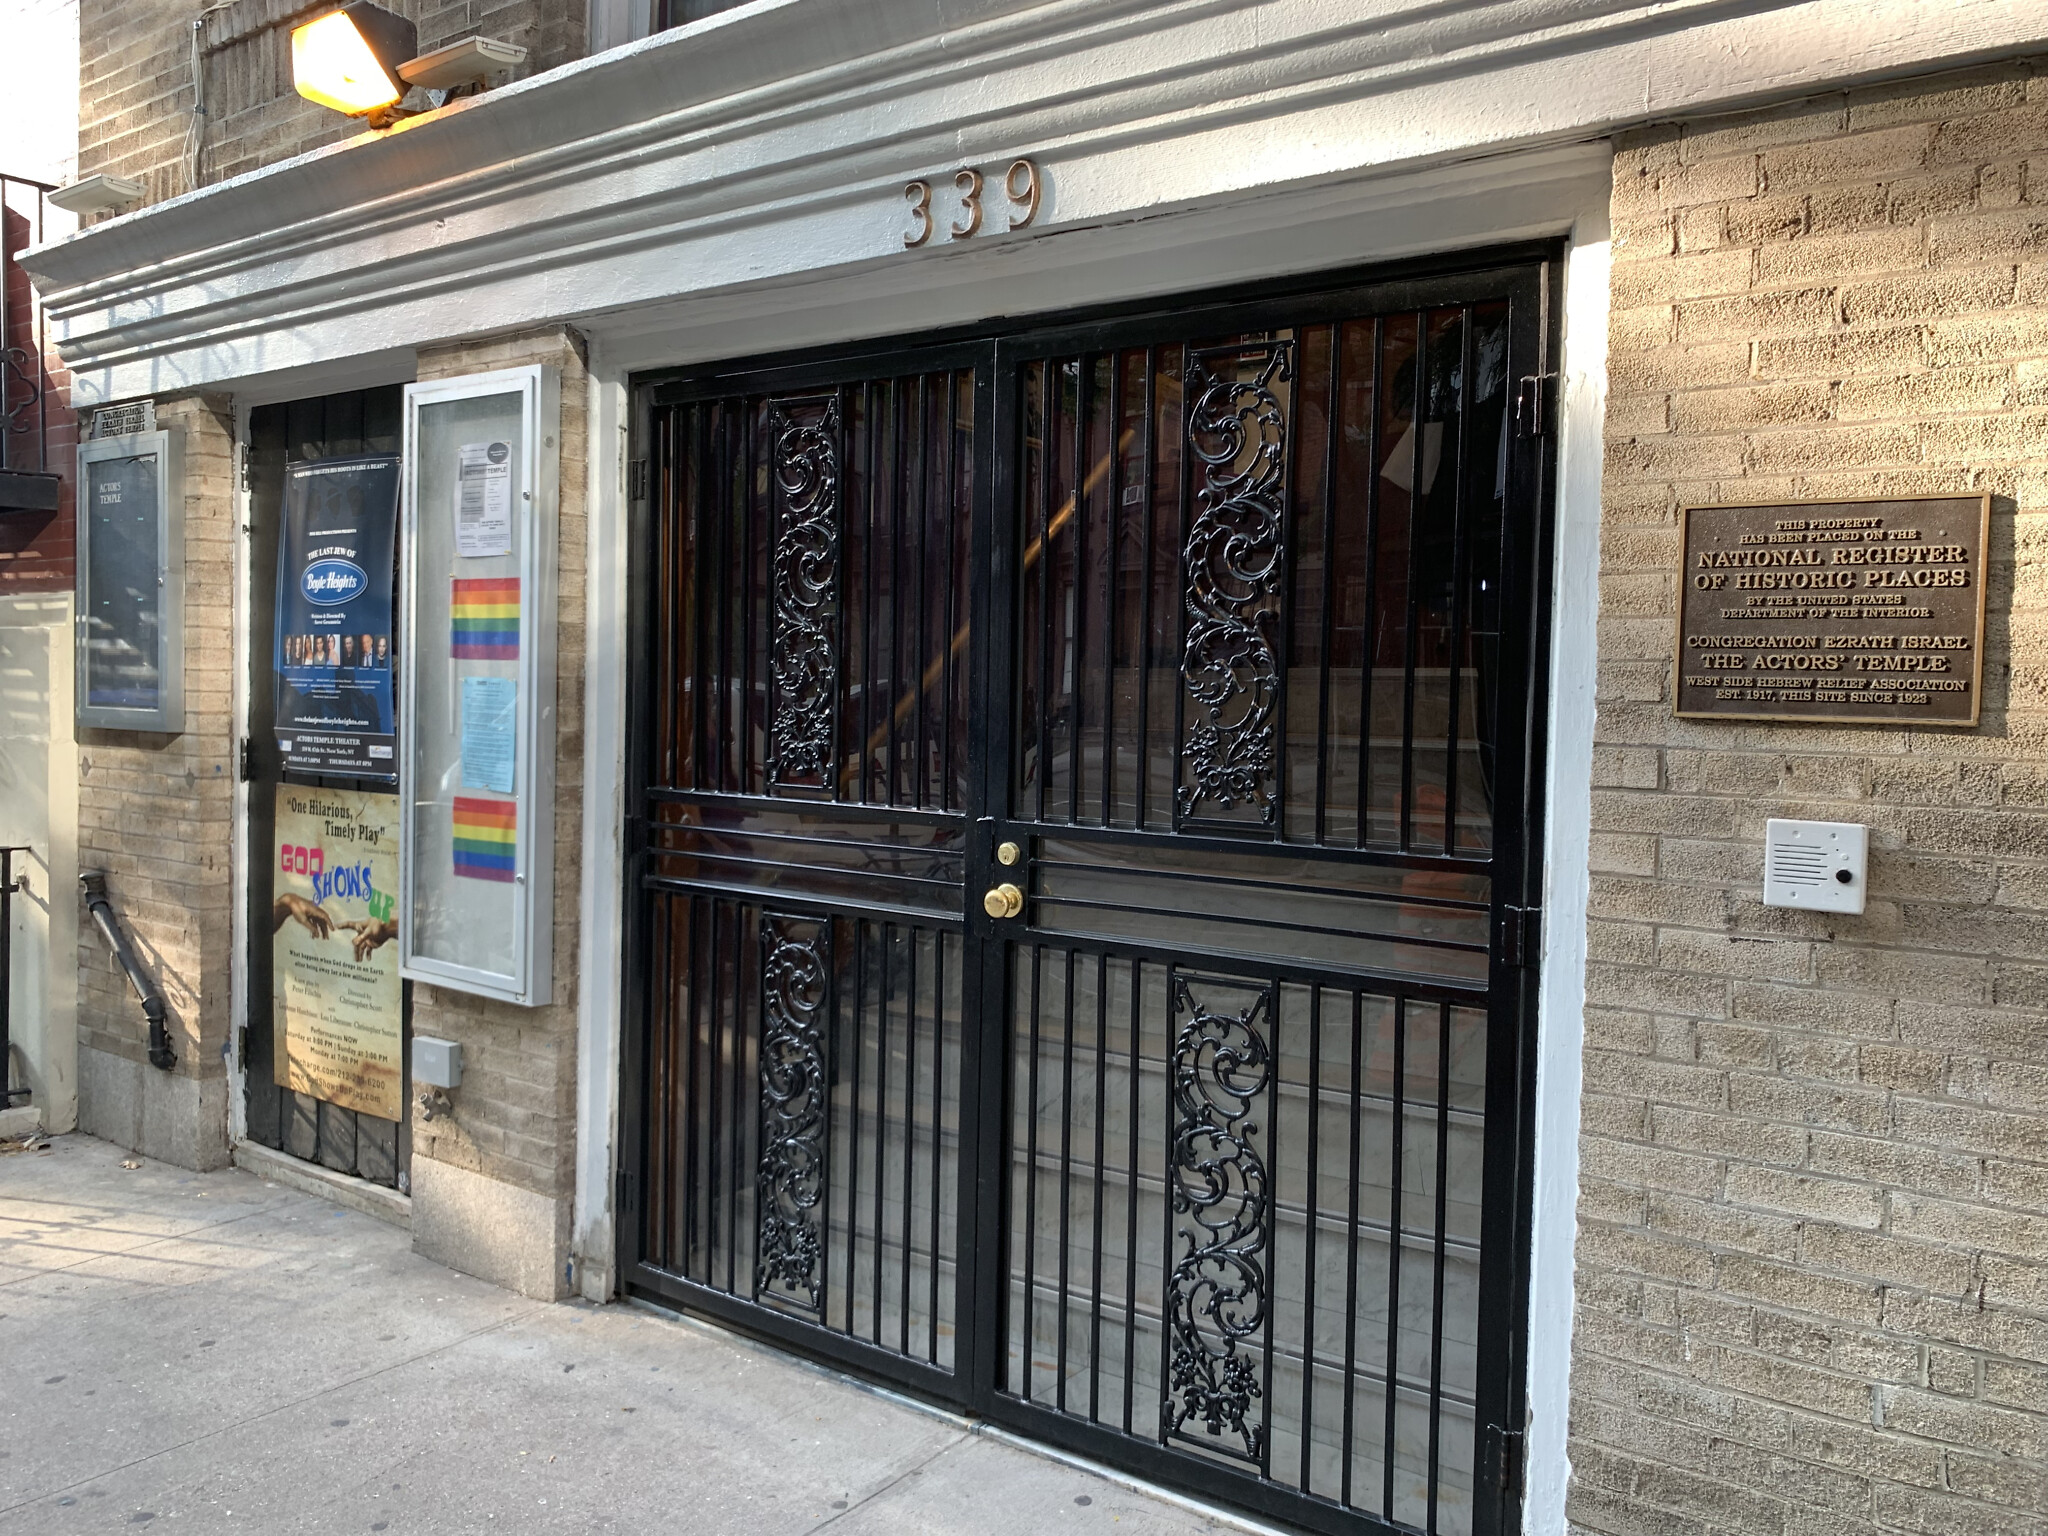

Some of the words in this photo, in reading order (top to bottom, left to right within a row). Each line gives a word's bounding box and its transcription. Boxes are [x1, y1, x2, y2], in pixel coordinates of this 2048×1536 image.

[904, 160, 1040, 248] 339
[100, 494, 121, 504] TEMPLE
[1776, 520, 1806, 531] THIS
[1810, 518, 1881, 529] PROPERTY
[1740, 534, 1764, 545] HAS
[1769, 533, 1803, 543] BEEN
[1808, 531, 1860, 542] PLACED
[1864, 530, 1883, 540] ON
[1888, 529, 1918, 540] THE
[308, 549, 319, 560] THE
[319, 547, 333, 556] LAST
[334, 547, 346, 555] JEW
[347, 549, 357, 558] OF
[1698, 549, 1822, 568] NATIONAL
[1831, 545, 1965, 565] REGISTER
[307, 573, 326, 593] Boyle
[326, 571, 357, 592] Heights
[1694, 574, 1726, 590] OF
[1735, 571, 1855, 589] HISTORIC
[1863, 569, 1967, 588] PLACES
[1746, 596, 1763, 606] BY
[1767, 596, 1793, 605] THE
[1798, 595, 1848, 605] UNITED
[1853, 594, 1903, 605] STATES
[1721, 608, 1806, 618] DEPARTMENT
[1810, 608, 1828, 618] OF
[1832, 608, 1859, 618] THE
[1863, 607, 1931, 618] INTERIOR
[1687, 636, 1817, 648] CONGREGATION
[1824, 636, 1894, 648] EZRATH
[1901, 636, 1967, 649] ISRAEL
[1700, 654, 1744, 669] THE
[1854, 655, 1948, 671] TEMPLE
[1685, 676, 1720, 687] WEST
[1724, 676, 1754, 687] SIDE
[1757, 677, 1813, 688] HEBREW
[1818, 678, 1867, 689] RELIEF
[1870, 679, 1966, 692] ASSOCIATION
[1716, 689, 1743, 700] EST.
[1780, 689, 1811, 701] THIS
[1816, 690, 1846, 702] SITE
[1850, 691, 1893, 703] SINCE
[1897, 692, 1928, 704] 1923
[314, 736, 334, 744] TEMPLE
[335, 737, 360, 745] THEATER
[309, 799, 353, 821] Hilarious,
[325, 820, 355, 842] Timely
[281, 844, 324, 877] GOD
[312, 860, 373, 907] SHOWS
[369, 888, 395, 924] UP
[370, 967, 384, 975] Earth
[324, 1040, 333, 1048] PM
[338, 1043, 356, 1055] Sunday
[344, 1035, 358, 1044] NOW
[310, 1047, 329, 1059] Monday
[350, 1058, 358, 1066] PM
